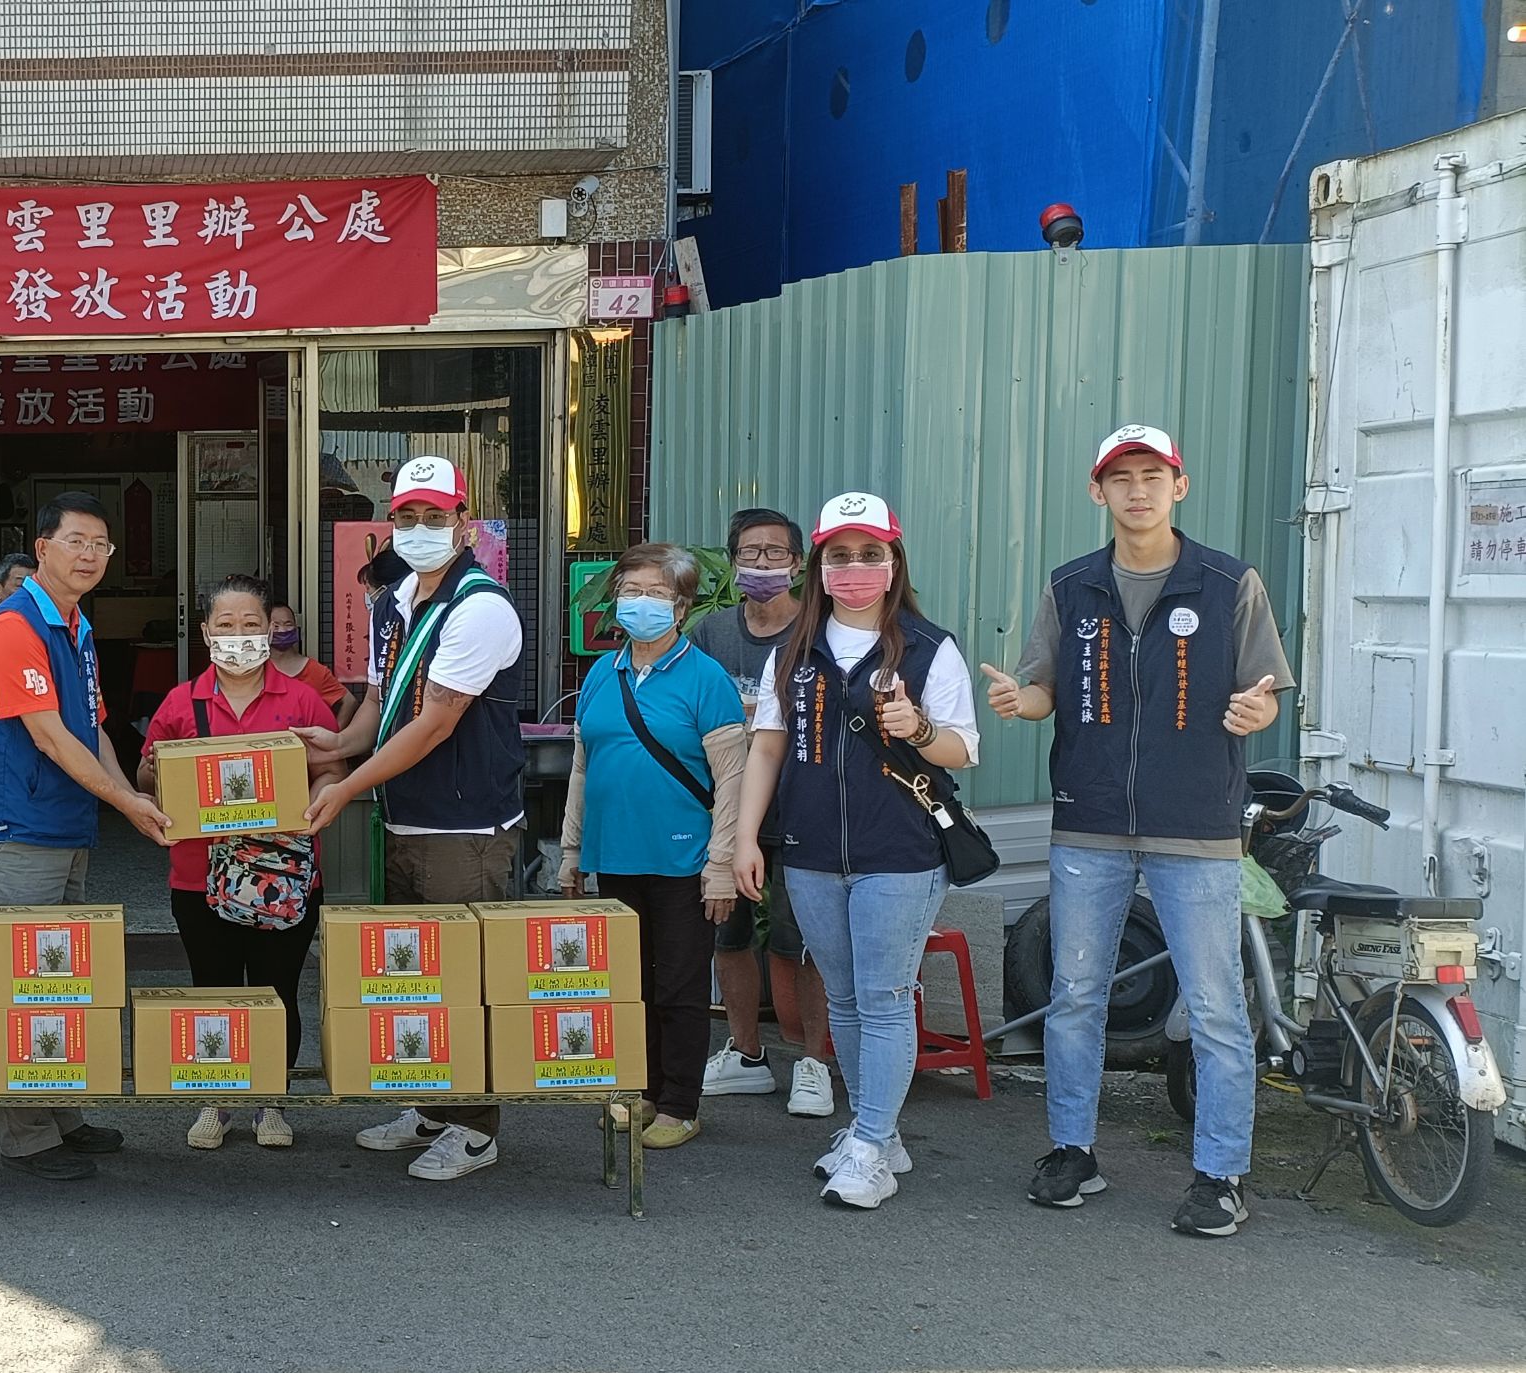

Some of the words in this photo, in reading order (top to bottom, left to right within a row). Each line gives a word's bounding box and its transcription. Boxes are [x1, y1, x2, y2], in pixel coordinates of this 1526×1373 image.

[608, 294, 640, 315] 42
[588, 393, 610, 544] 凌雲里辦公處
